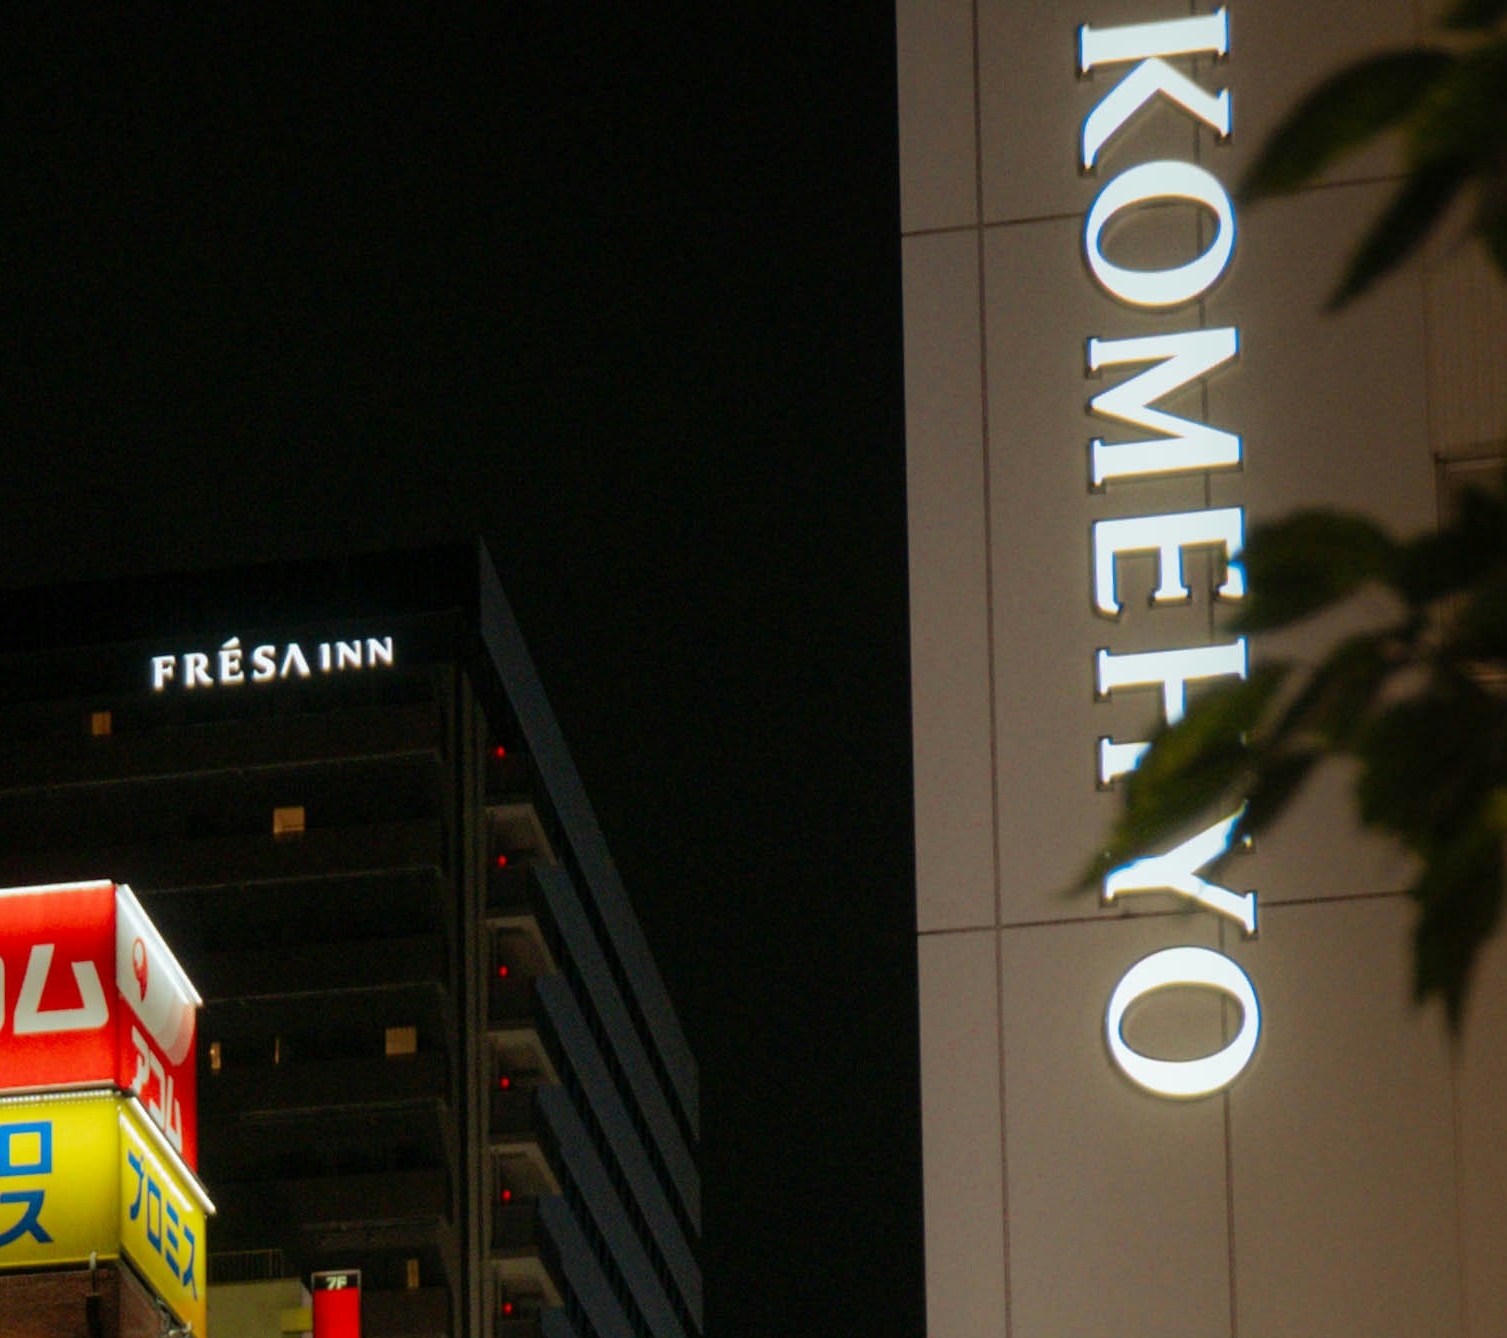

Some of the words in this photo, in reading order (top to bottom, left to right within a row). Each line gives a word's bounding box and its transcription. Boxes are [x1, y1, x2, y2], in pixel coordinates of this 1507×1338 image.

[1078, 6, 1260, 1098] KOMEHYO
[152, 637, 310, 691] FRÉSA
[319, 637, 393, 672] INN
[132, 1025, 182, 1155] アコム
[128, 1148, 197, 1300] プロミス
[326, 1276, 347, 1291] 7F
